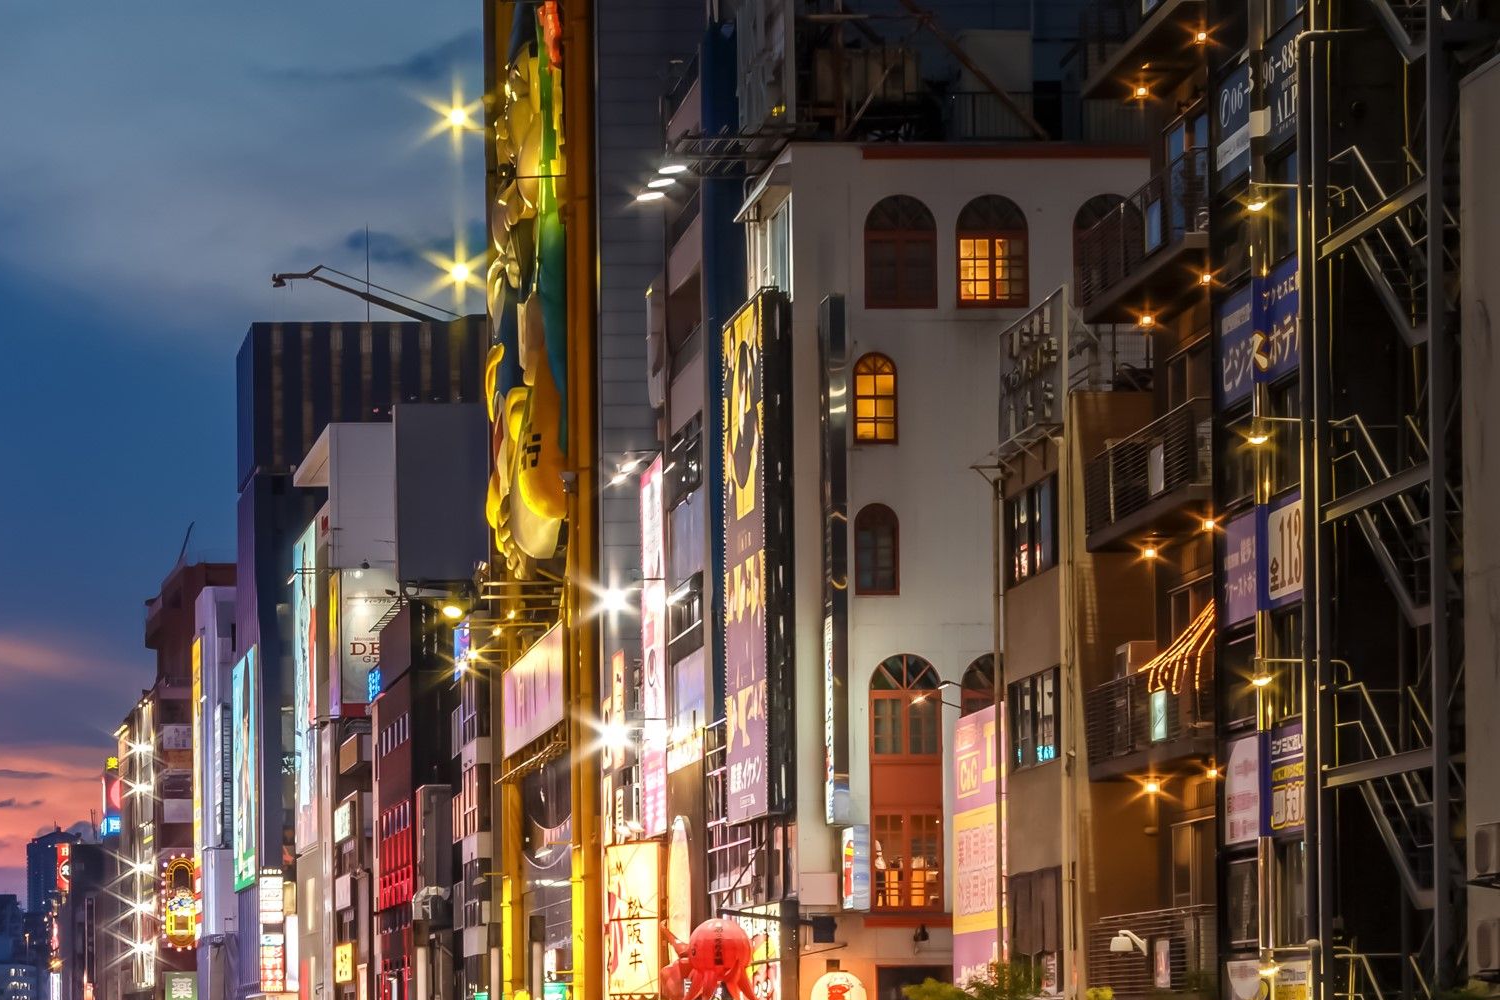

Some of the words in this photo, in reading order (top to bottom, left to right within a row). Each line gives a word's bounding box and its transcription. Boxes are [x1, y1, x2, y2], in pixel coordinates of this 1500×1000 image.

[1276, 83, 1299, 124] ALP
[350, 642, 380, 656] DE
[626, 898, 644, 972] 松阪牛
